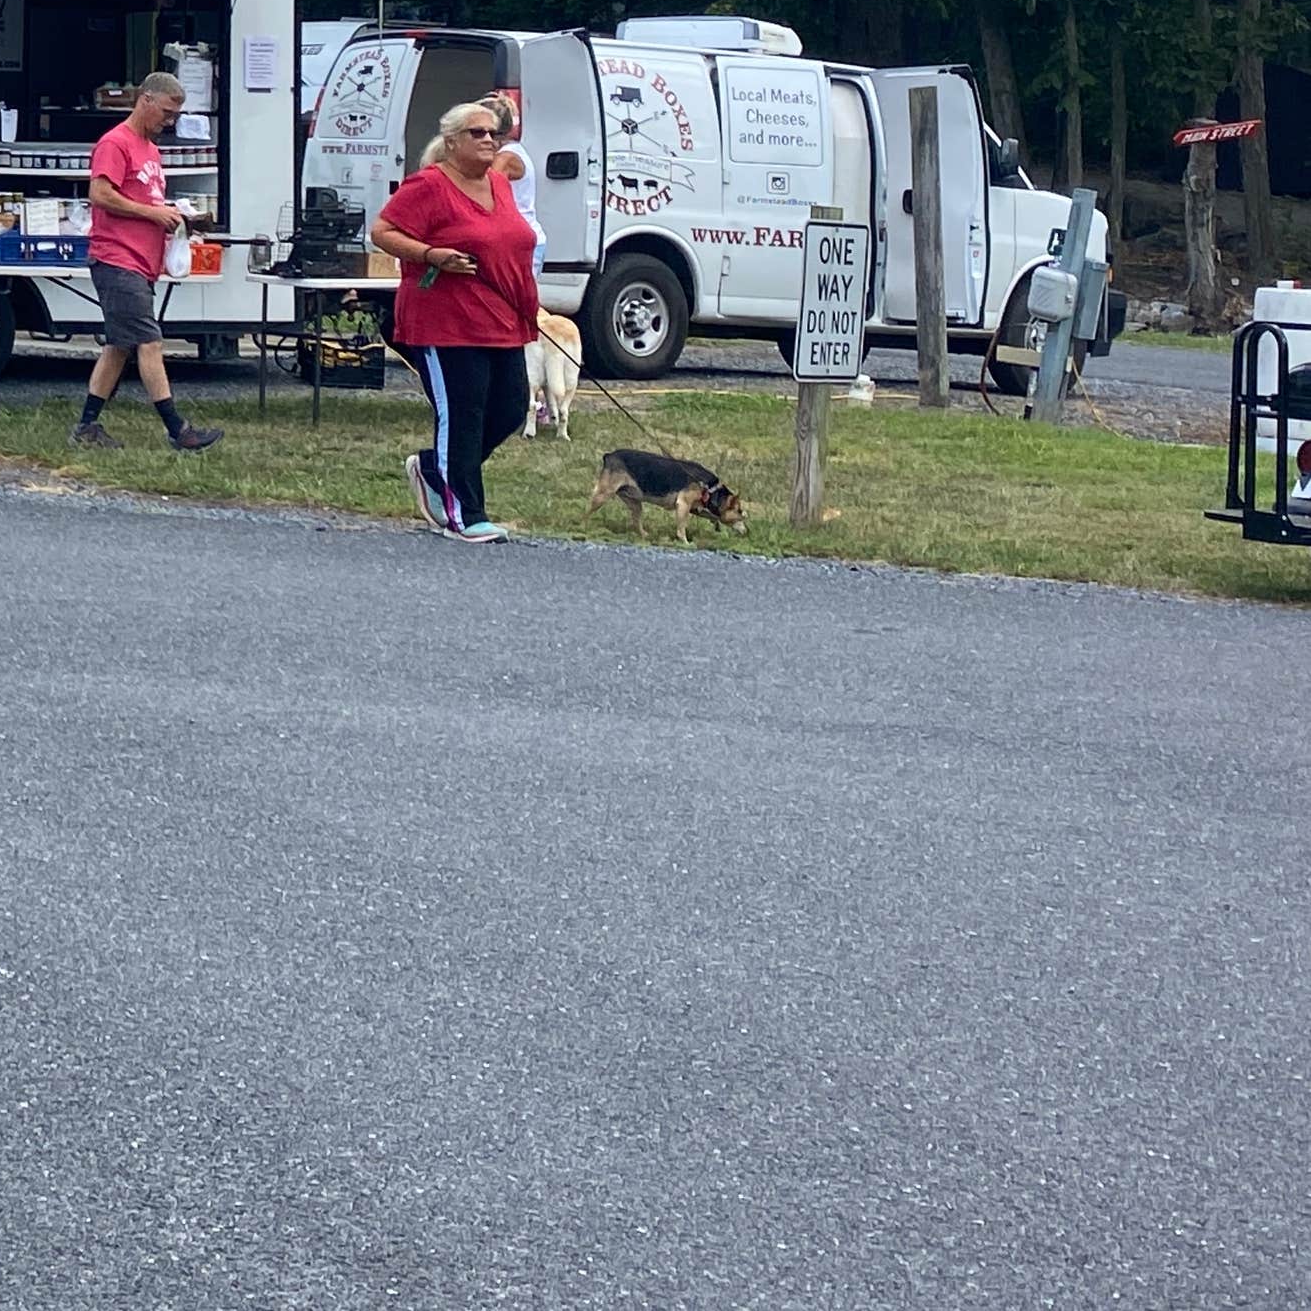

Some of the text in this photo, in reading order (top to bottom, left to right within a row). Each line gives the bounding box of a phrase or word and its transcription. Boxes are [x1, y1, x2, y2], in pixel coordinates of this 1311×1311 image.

[732, 87, 817, 106] Local Meats,
[651, 73, 694, 152] BOXES
[746, 109, 809, 128] Cheeses,
[739, 129, 817, 148] and more...
[1209, 123, 1255, 140] STREET
[819, 237, 854, 266] ONE
[818, 273, 854, 303] WAY
[807, 309, 858, 335] DO NOT
[810, 341, 850, 366] ENTER
